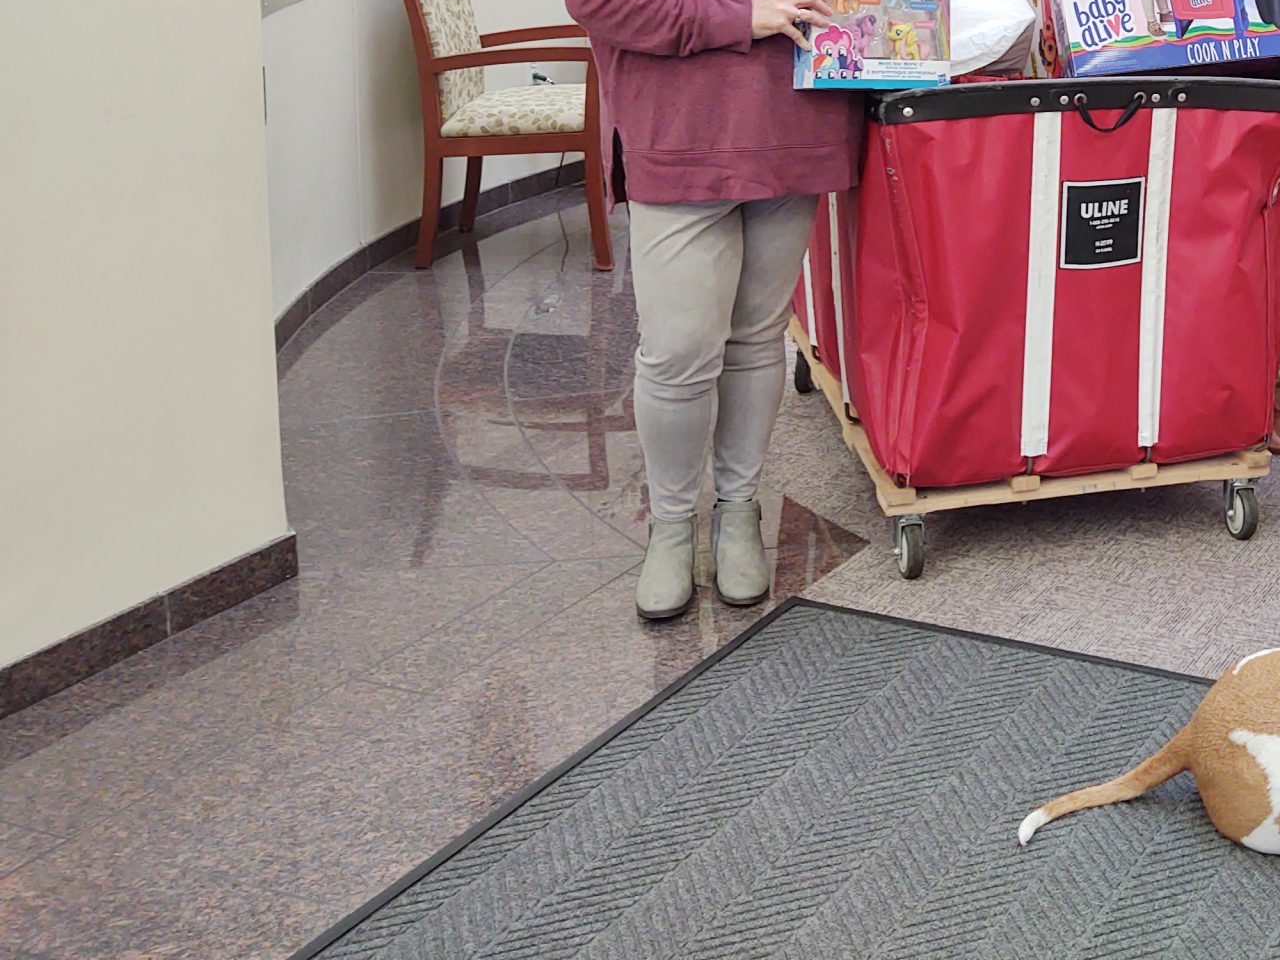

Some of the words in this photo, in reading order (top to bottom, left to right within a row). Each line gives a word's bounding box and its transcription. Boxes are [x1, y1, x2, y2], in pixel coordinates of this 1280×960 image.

[1186, 41, 1219, 64] COOK
[1221, 40, 1231, 60] N
[1233, 37, 1261, 60] PLAY
[1080, 198, 1129, 219] ULINE
